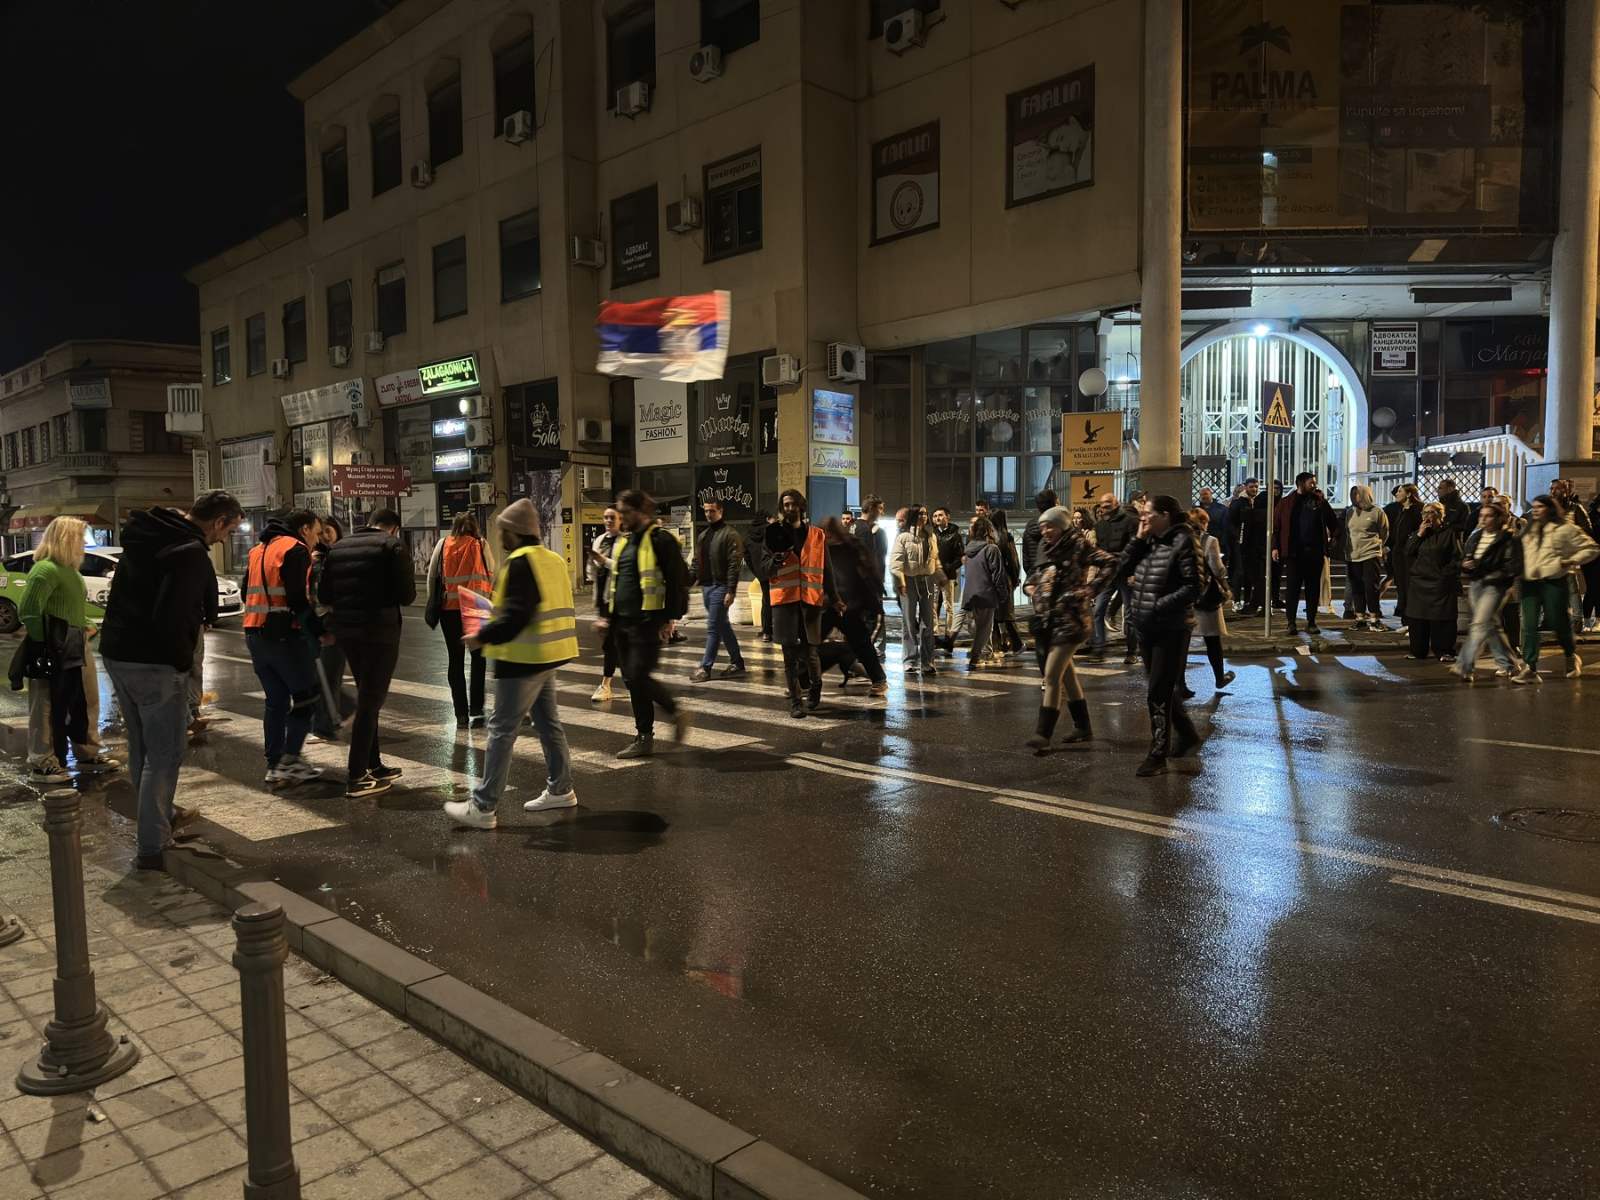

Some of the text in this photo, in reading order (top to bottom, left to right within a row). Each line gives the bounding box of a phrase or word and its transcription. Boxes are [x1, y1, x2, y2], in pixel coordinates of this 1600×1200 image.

[1210, 69, 1318, 101] PALMA
[422, 360, 473, 380] ZALAGAONICA
[640, 400, 682, 425] Magic
[645, 427, 677, 440] FASHION
